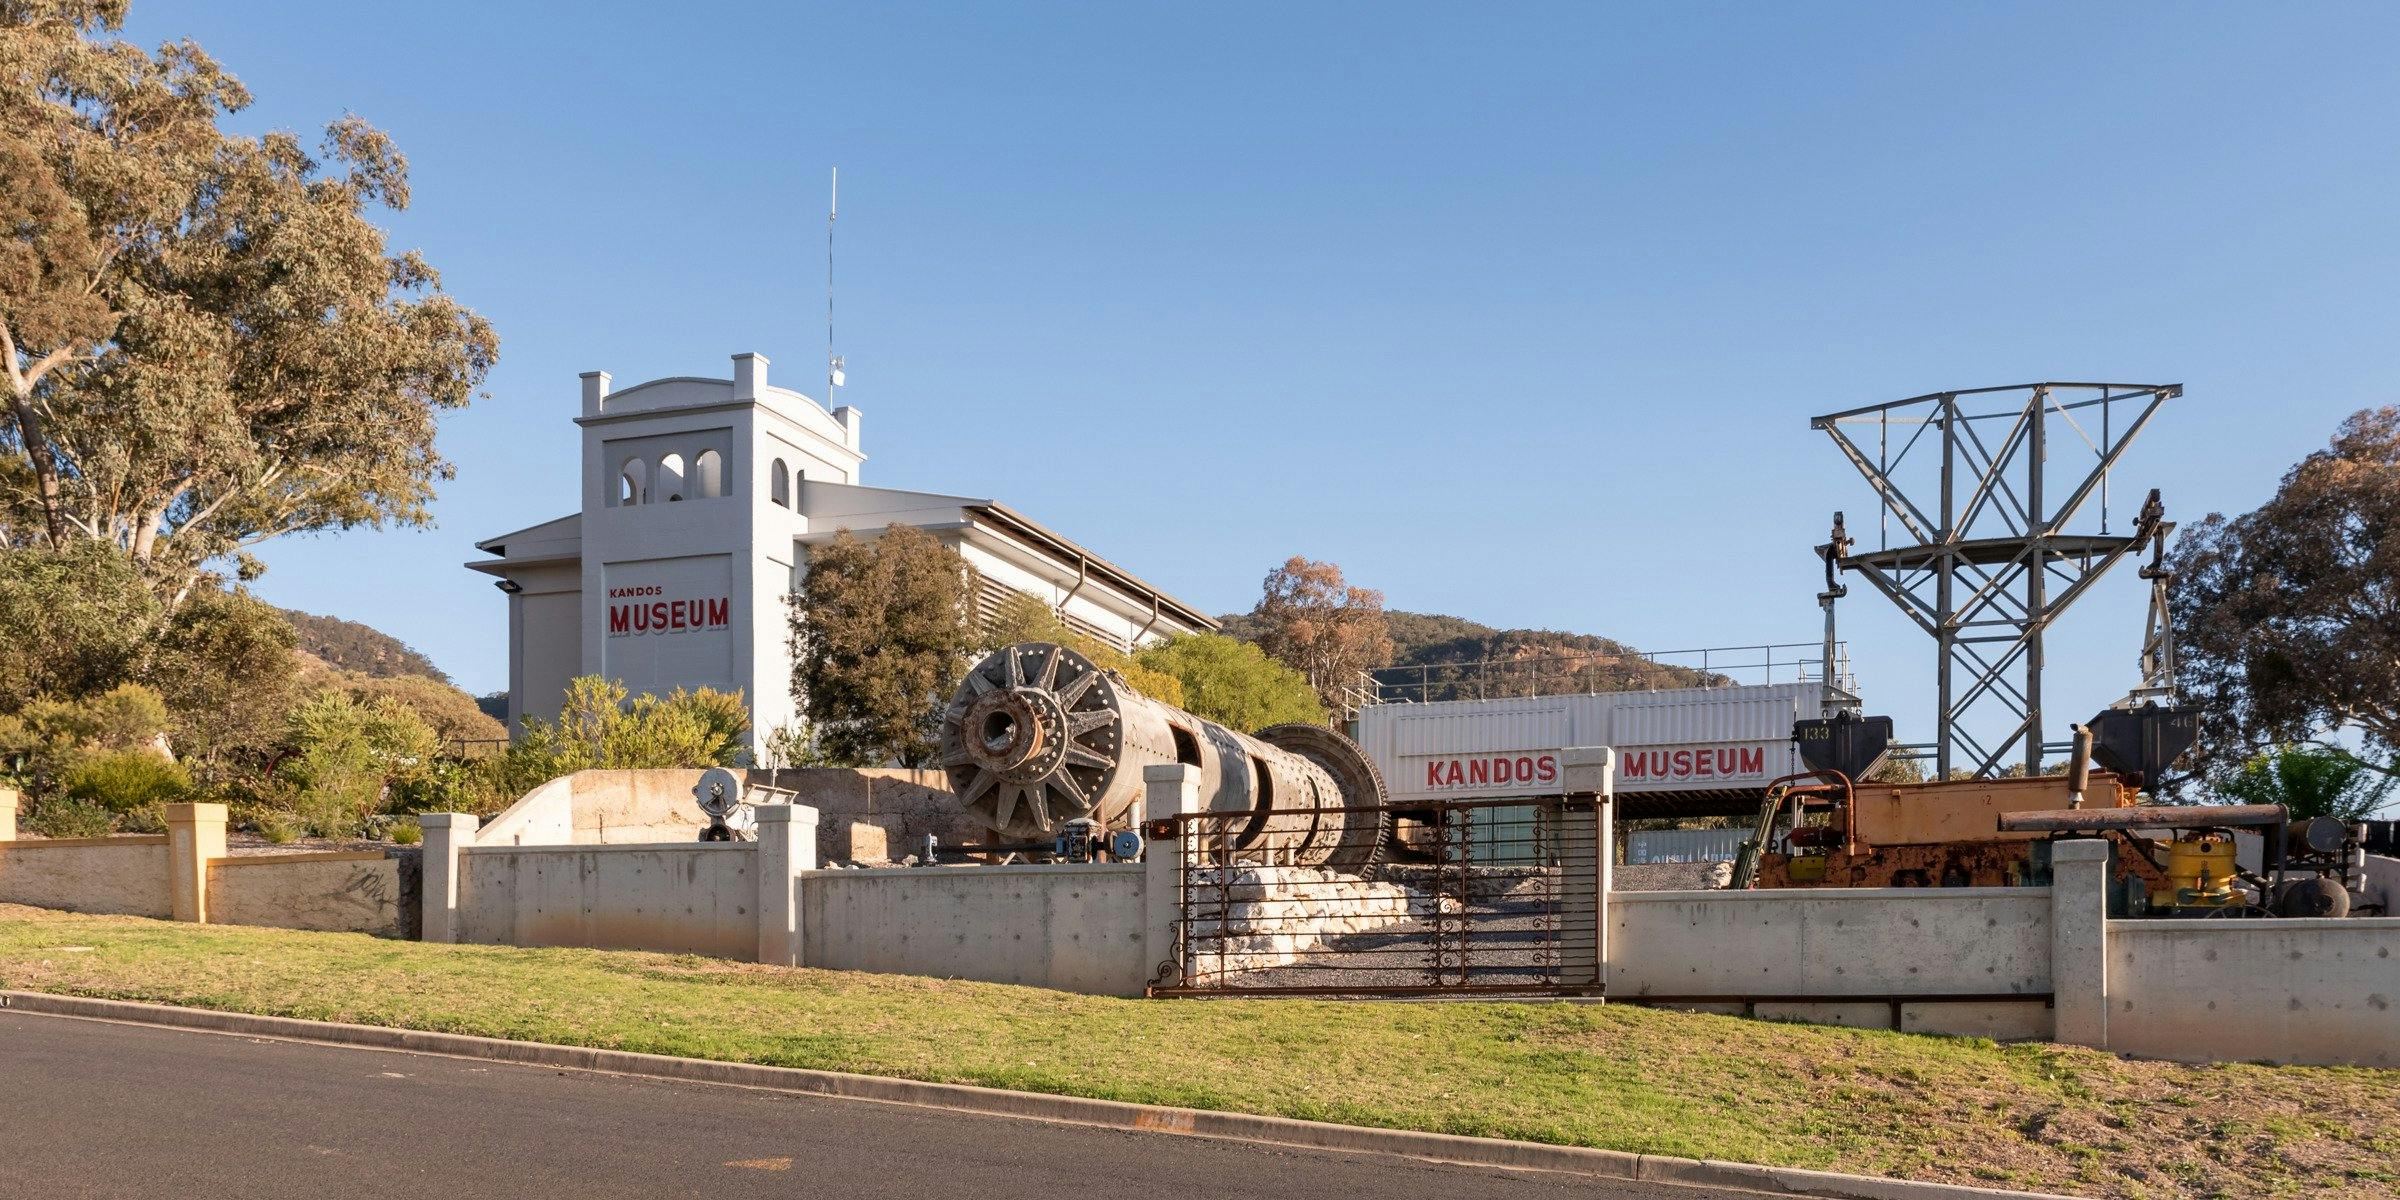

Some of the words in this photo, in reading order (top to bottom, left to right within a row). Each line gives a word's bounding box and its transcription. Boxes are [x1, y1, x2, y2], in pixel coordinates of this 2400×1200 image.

[610, 586, 663, 599] KANDOS
[610, 597, 729, 634] MUSEUM
[1804, 727, 1830, 740] 133
[1427, 755, 1558, 787] KANDOS
[1624, 746, 1764, 778] MUSEUM
